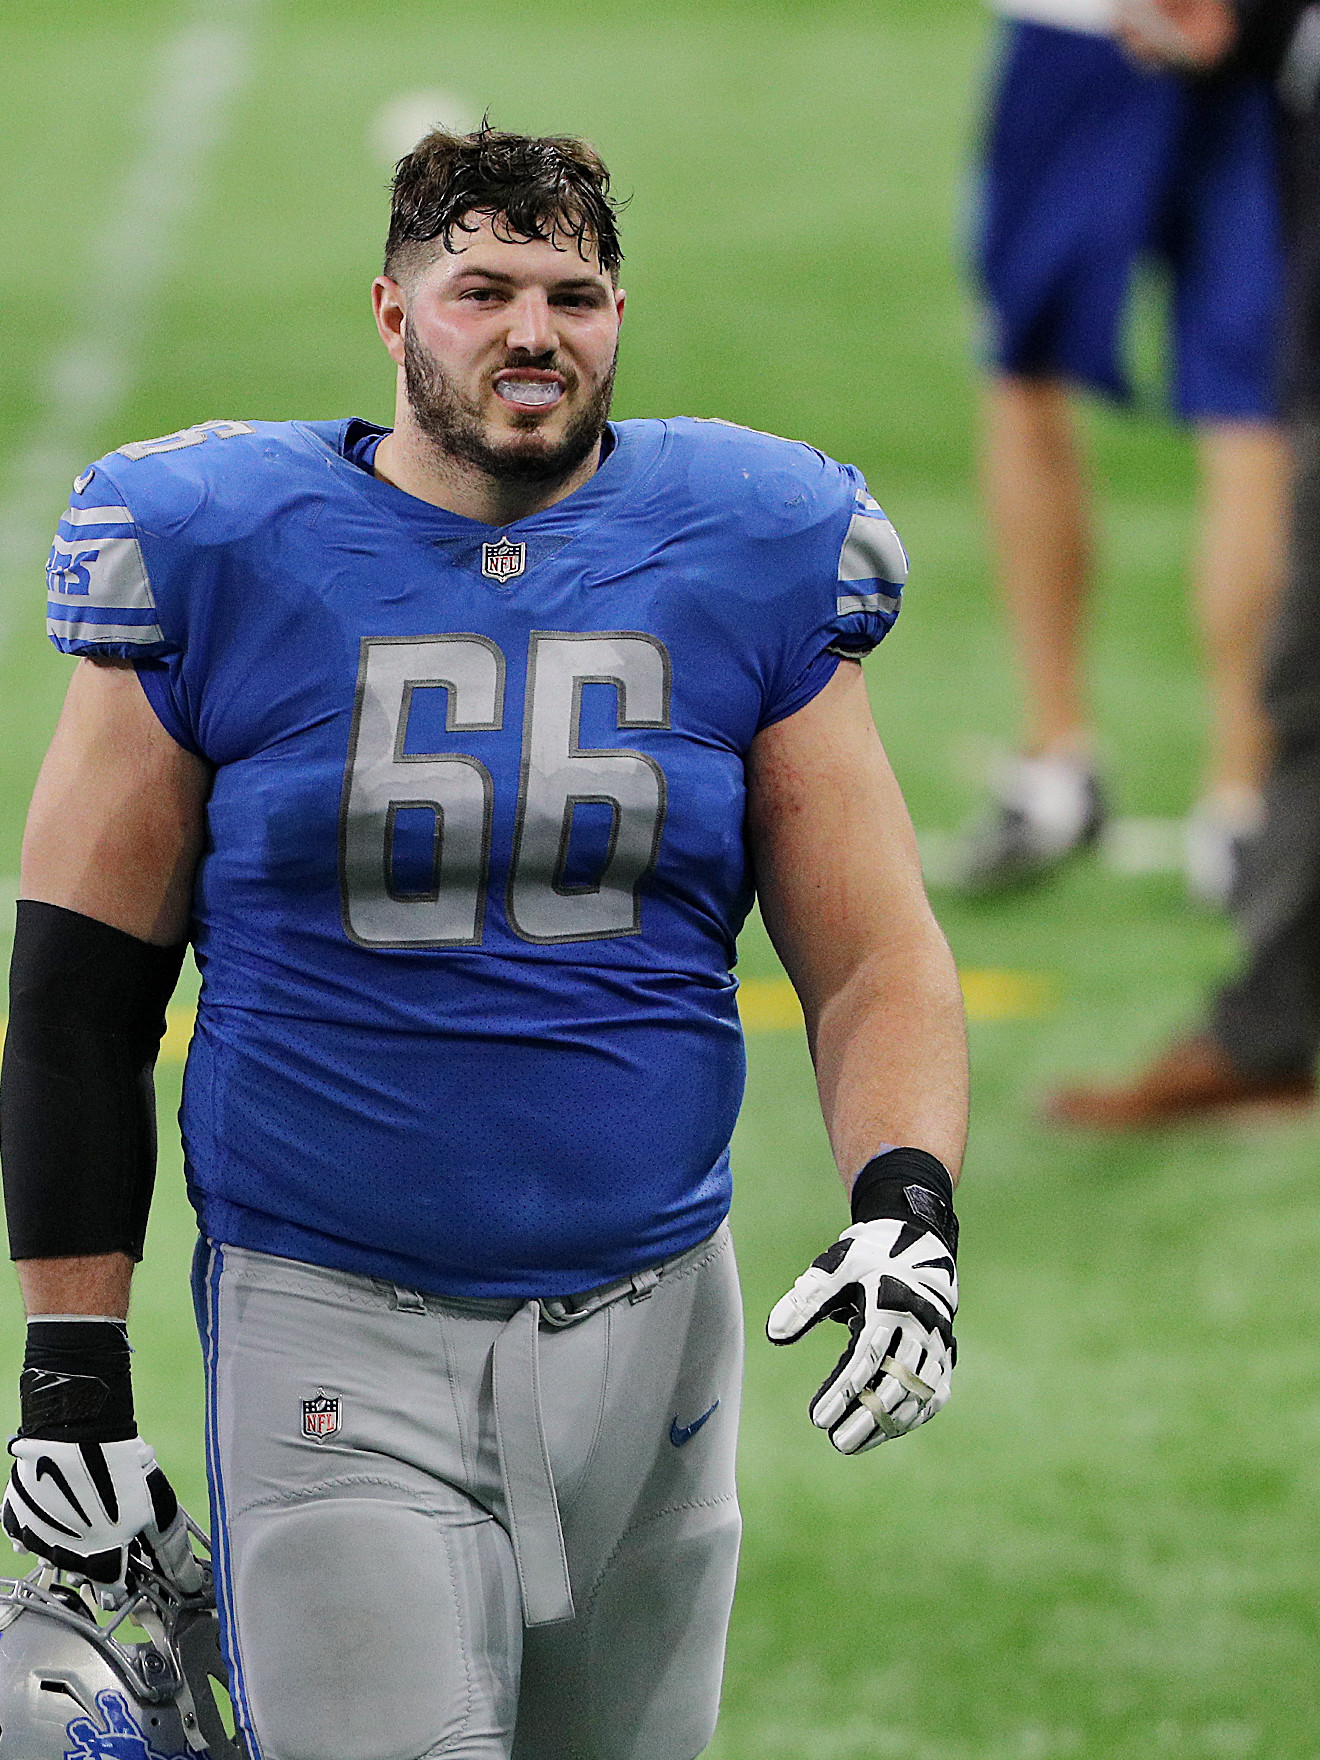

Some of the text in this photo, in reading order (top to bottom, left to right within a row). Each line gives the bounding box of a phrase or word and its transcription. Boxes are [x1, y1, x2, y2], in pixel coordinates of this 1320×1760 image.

[489, 556, 517, 573] NFL
[338, 629, 672, 949] 66
[306, 1413, 335, 1434] NFL
